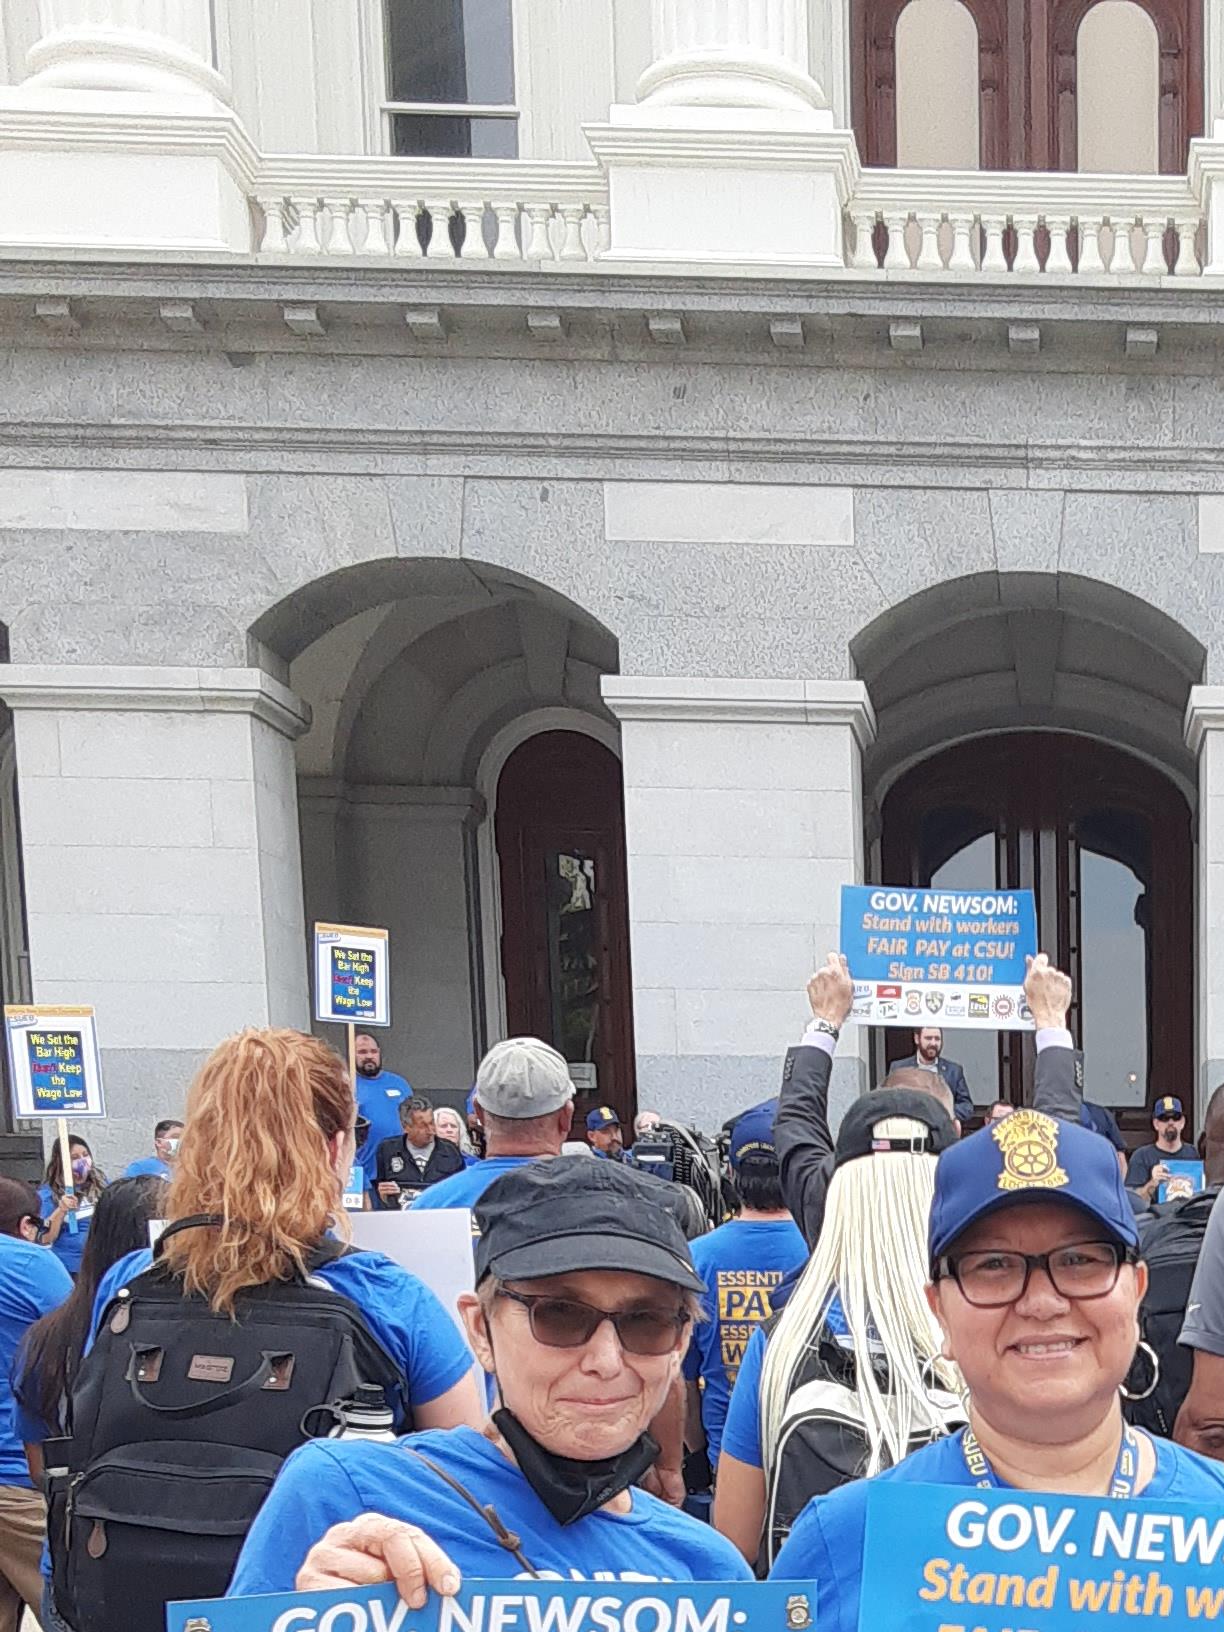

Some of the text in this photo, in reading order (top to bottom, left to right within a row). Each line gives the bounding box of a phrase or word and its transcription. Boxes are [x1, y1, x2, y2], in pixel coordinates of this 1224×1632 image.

[870, 892, 1018, 915] GOV. NEWSOM:
[863, 913, 1019, 935] Stand with workers
[867, 936, 1015, 960] FAIR PAY at CSU!
[888, 961, 993, 981] Sign SB 410!
[946, 1500, 1077, 1558] GOV.
[918, 1557, 1060, 1609] Stand
[1068, 1567, 1174, 1617] with
